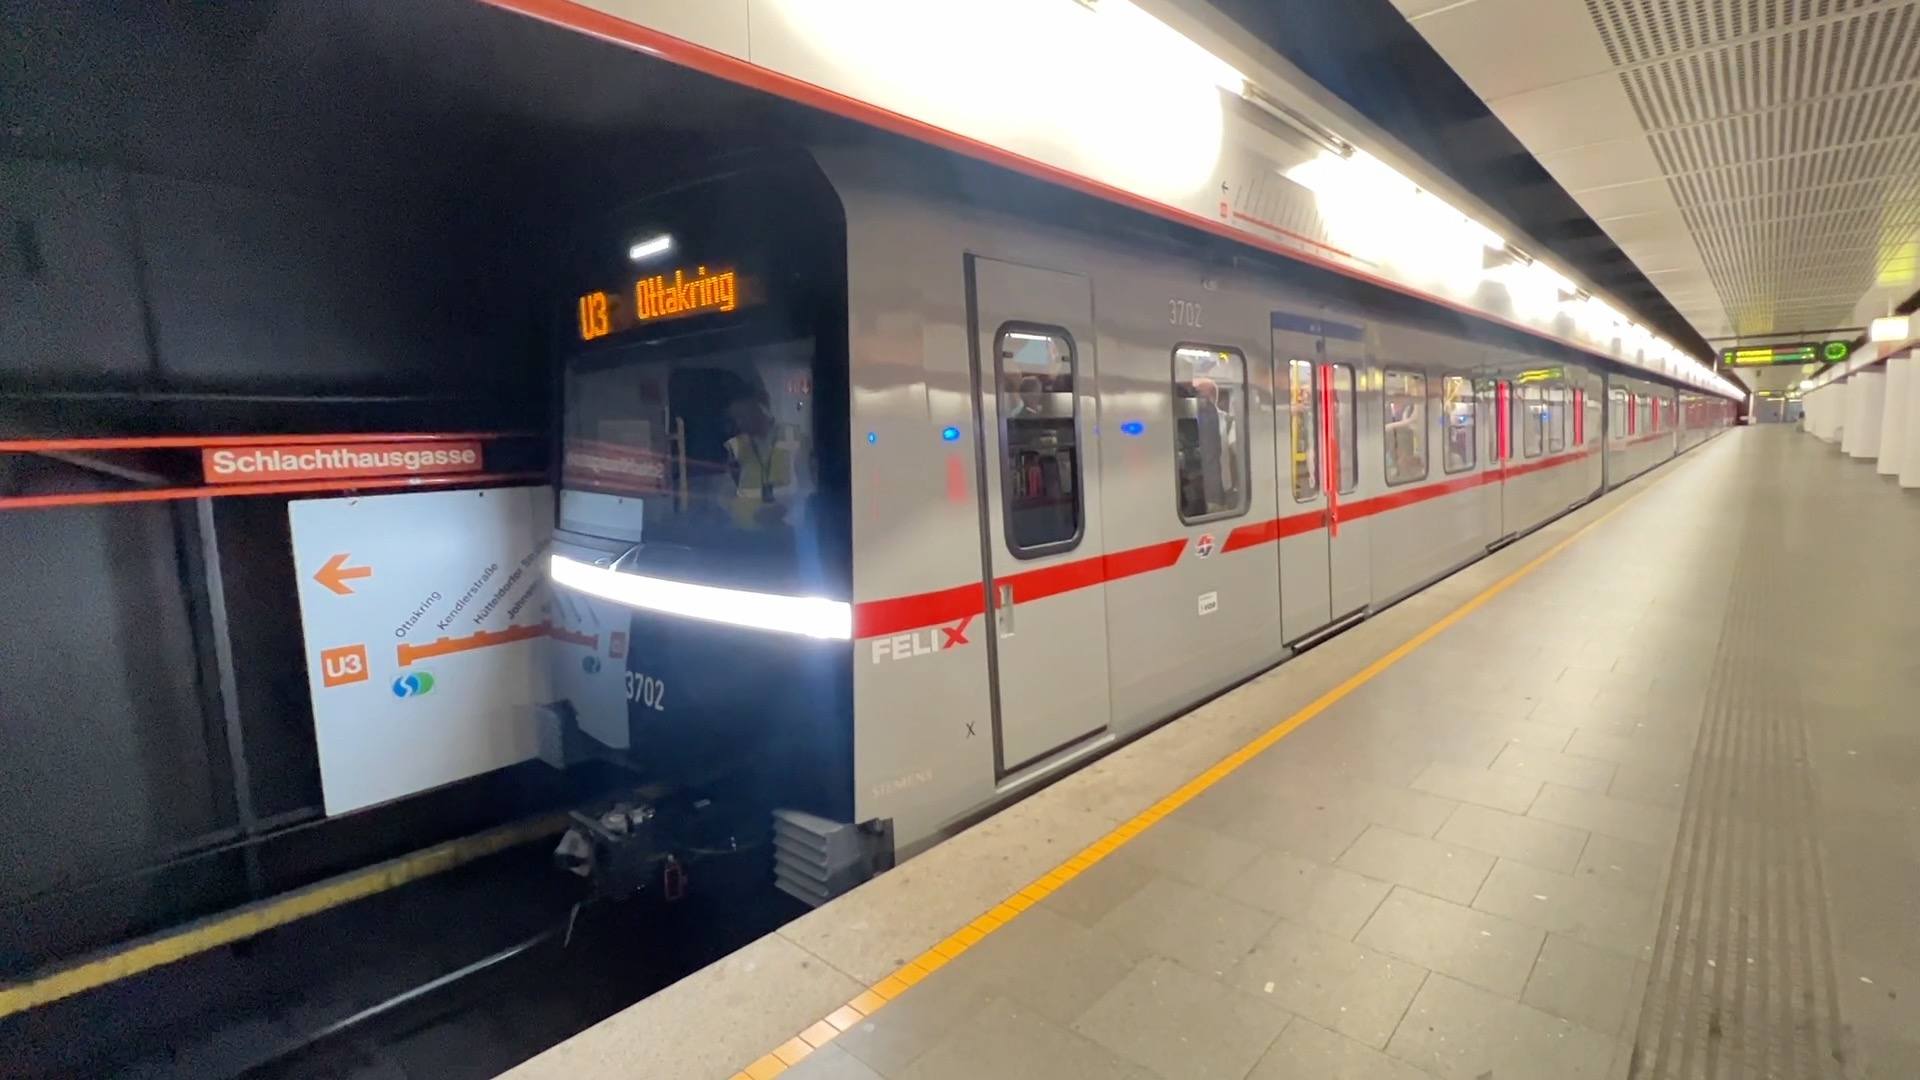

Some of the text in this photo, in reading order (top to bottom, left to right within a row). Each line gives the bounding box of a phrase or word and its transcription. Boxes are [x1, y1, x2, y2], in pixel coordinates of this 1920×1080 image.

[580, 266, 735, 341] U3 Ottakring
[1169, 298, 1203, 328] 3702
[212, 447, 477, 475] Schlachthausgasse
[394, 590, 442, 638] Ottakring
[437, 562, 499, 631] Kendlerstraße
[472, 566, 524, 625] Hütteldorfer
[871, 615, 975, 664] FELIX
[325, 654, 362, 679] U3
[624, 670, 665, 712] 3702
